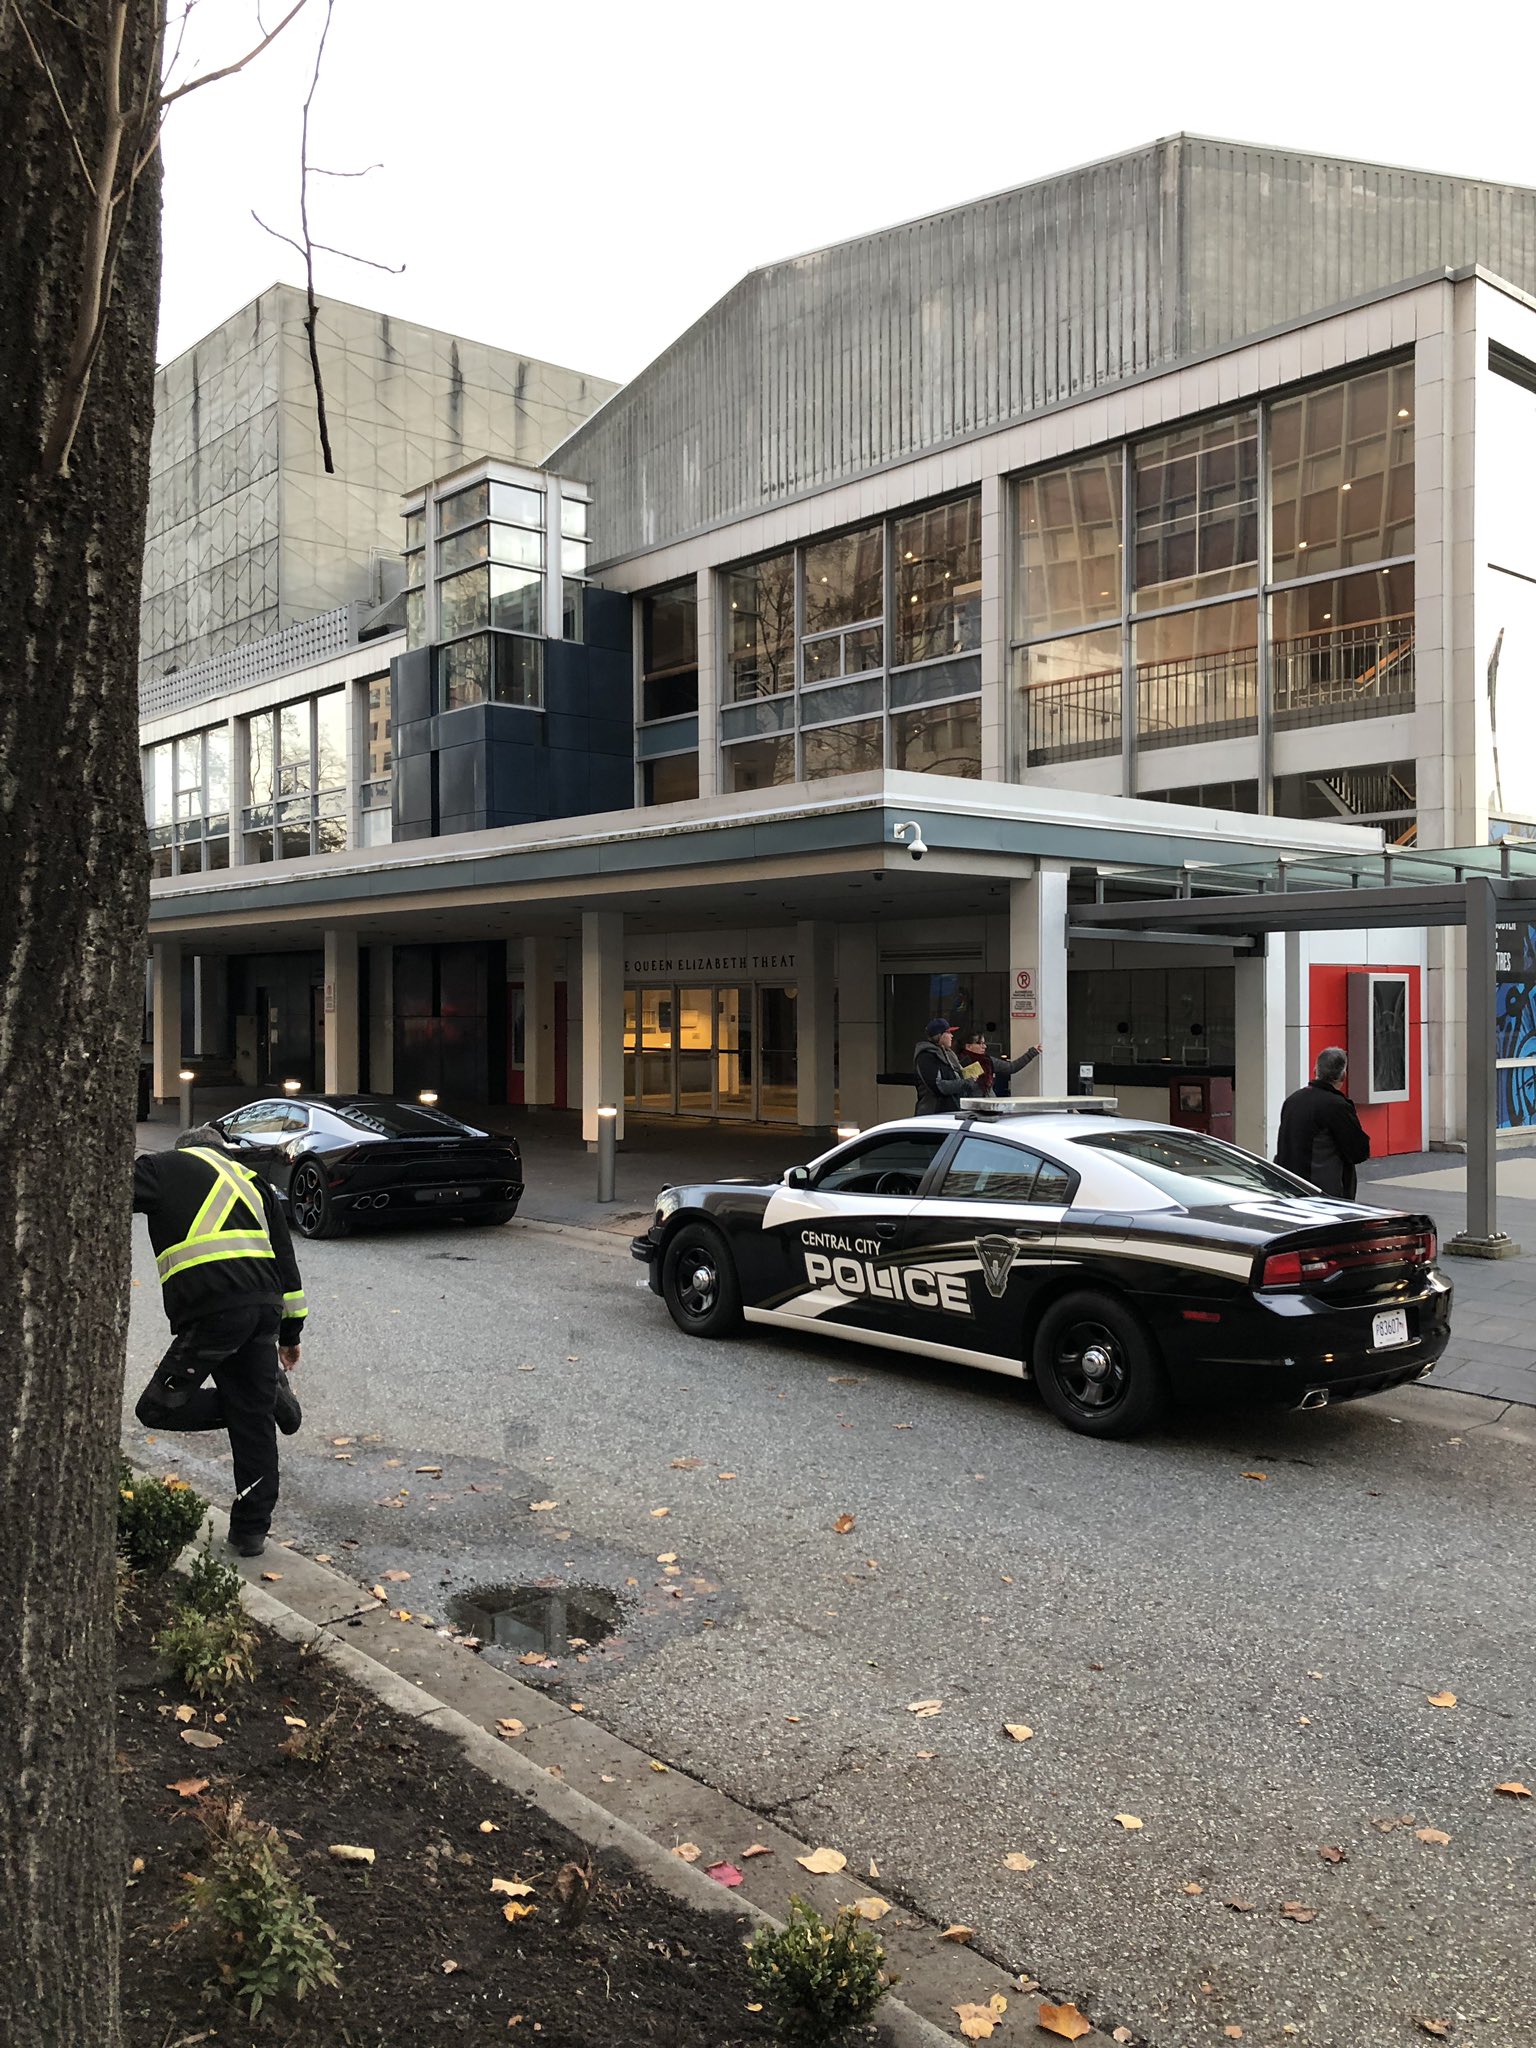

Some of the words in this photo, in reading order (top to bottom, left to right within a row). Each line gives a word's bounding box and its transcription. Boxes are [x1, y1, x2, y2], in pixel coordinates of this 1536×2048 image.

[634, 959, 673, 972] QUEEN
[678, 957, 747, 970] ELIZABETH
[752, 955, 795, 968] THEAT
[1495, 951, 1511, 971] TRES
[801, 1230, 852, 1251] CENTRAL
[854, 1238, 881, 1256] CITY
[804, 1252, 972, 1314] POLICE
